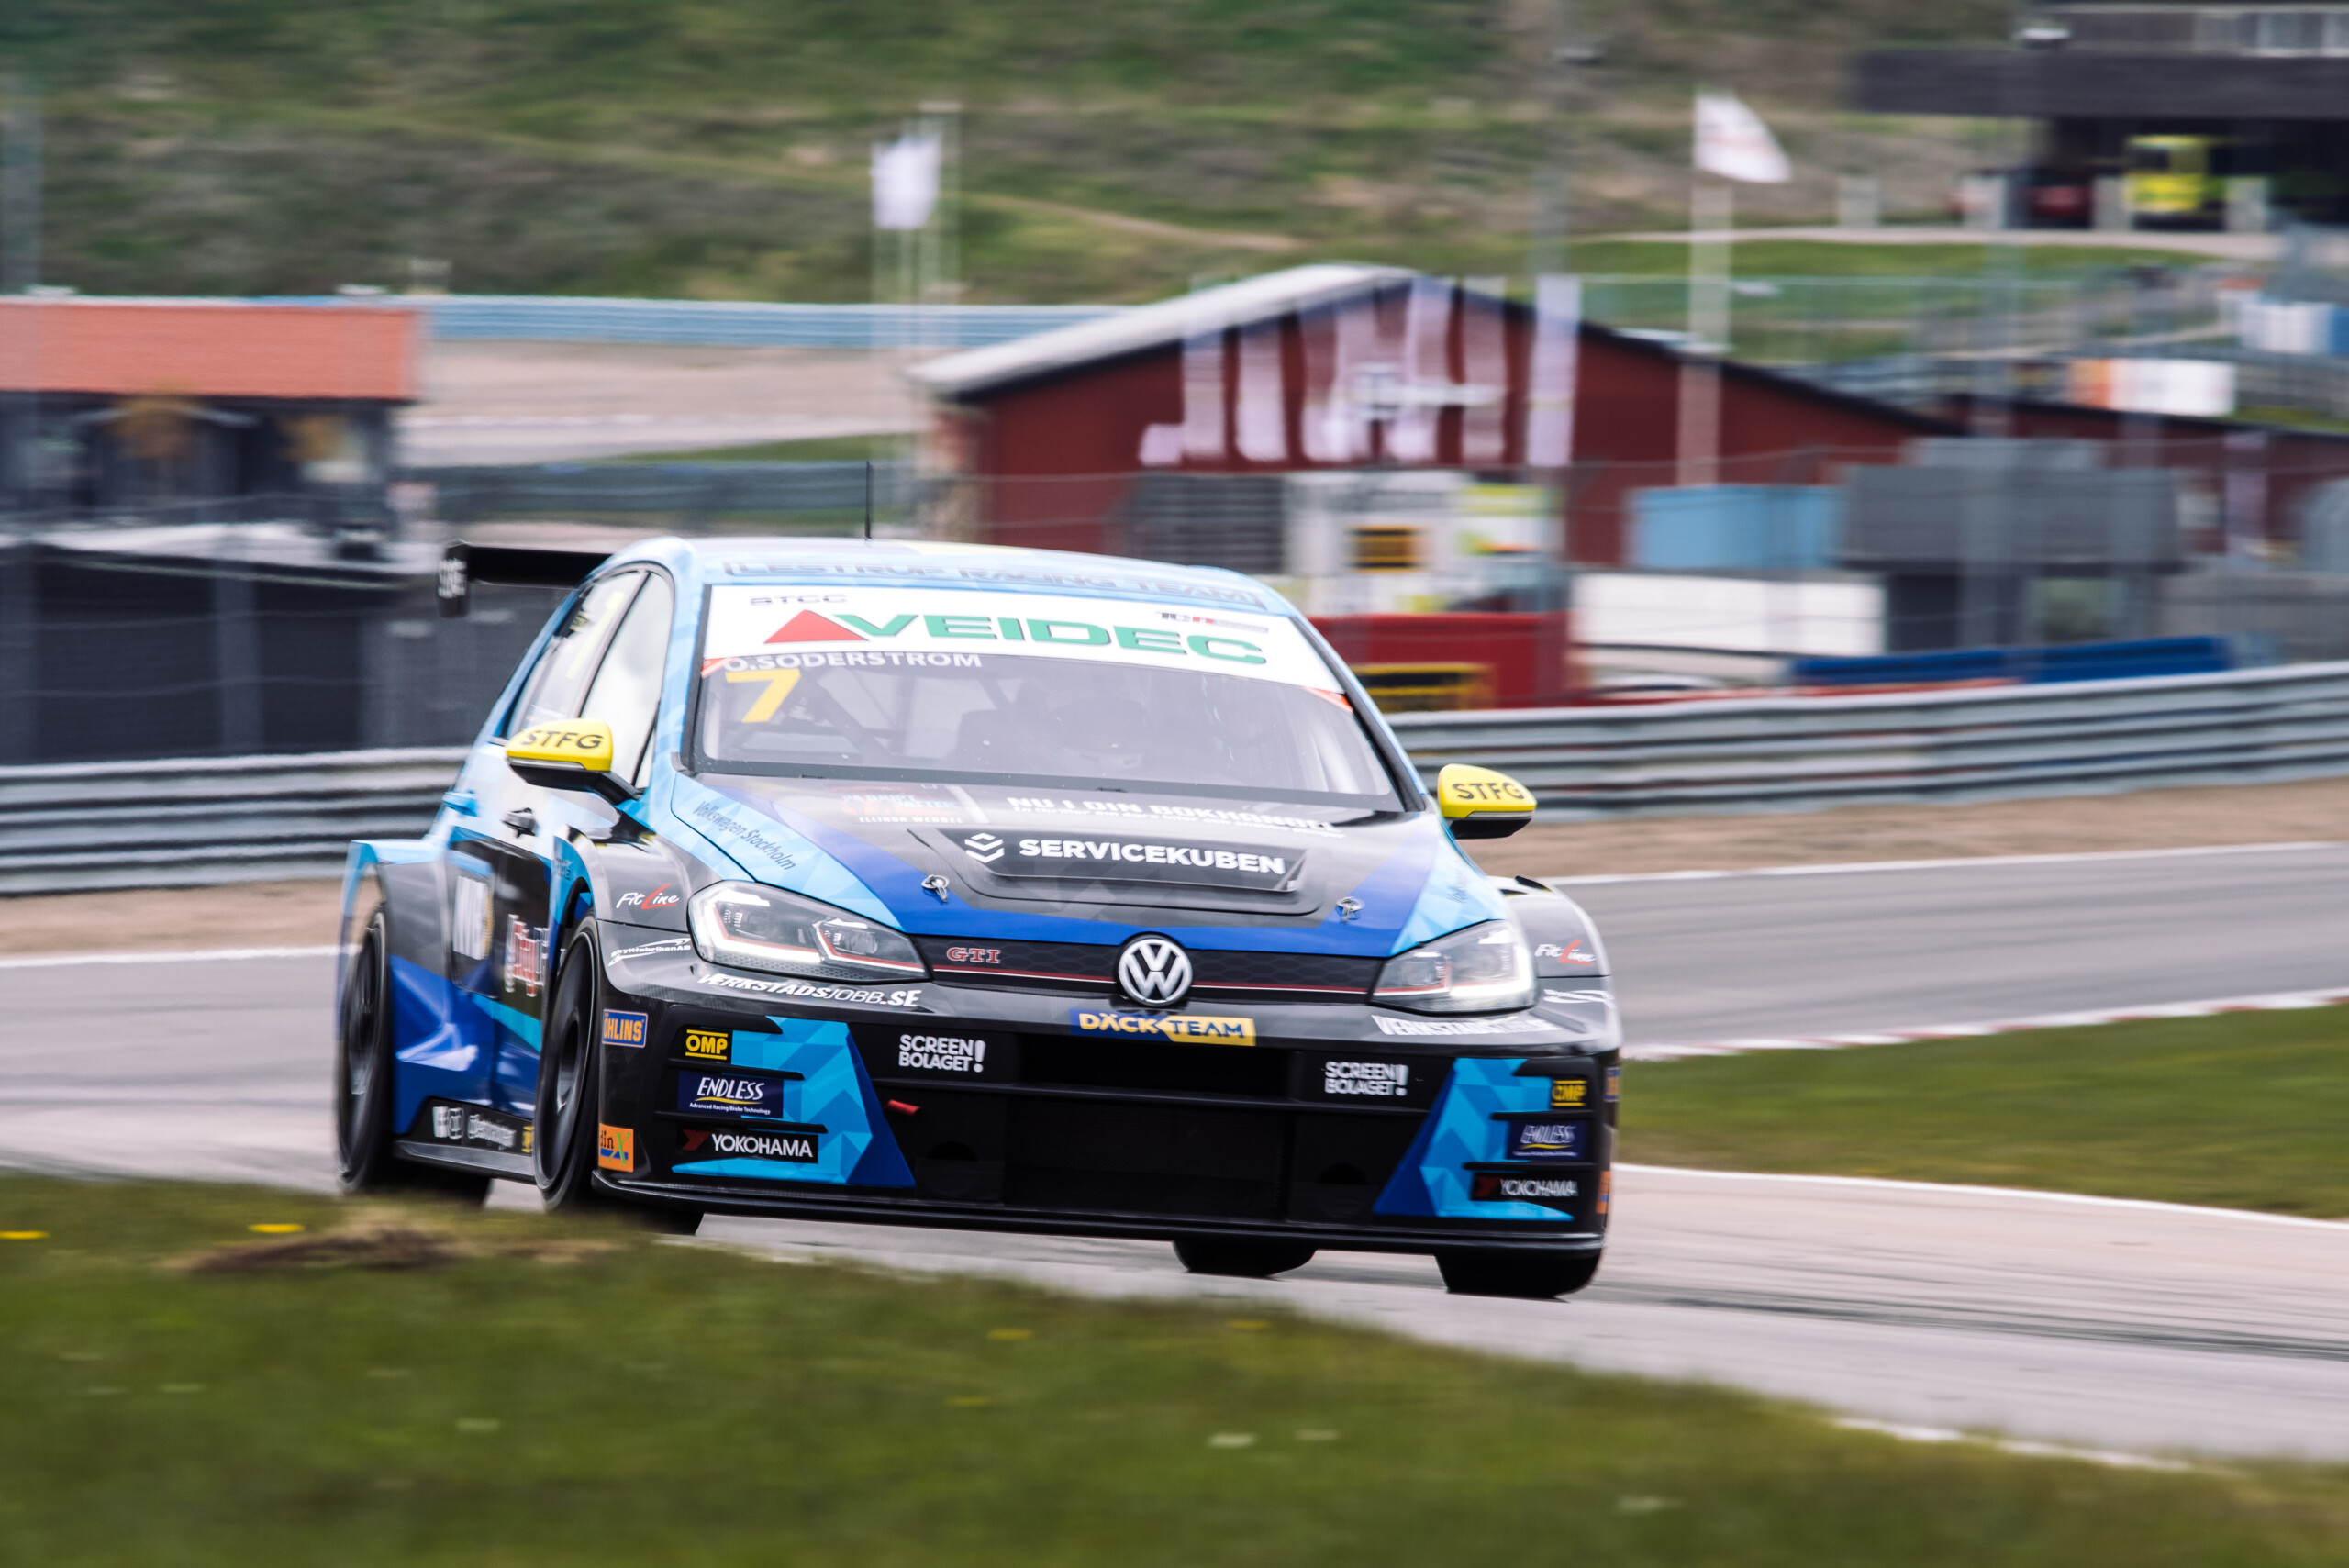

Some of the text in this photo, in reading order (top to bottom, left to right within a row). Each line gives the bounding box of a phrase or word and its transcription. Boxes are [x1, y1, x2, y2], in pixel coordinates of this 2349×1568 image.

[833, 614, 1266, 664] VEIDEC
[725, 668, 801, 723] 7
[521, 729, 604, 750] STFG
[1453, 782, 1525, 800] STFG
[1007, 797, 1055, 808] NU
[1062, 799, 1076, 809] I
[1083, 801, 1143, 813] DIN
[693, 800, 796, 870] Volkswagen Stockholm
[1019, 839, 1285, 874] SERVICEKUBEN
[946, 946, 1002, 964] GTI
[603, 1013, 643, 1042] ÖHLINS
[1079, 1012, 1247, 1039] DÄCK TEAM
[685, 1032, 728, 1056] OMP
[899, 1034, 974, 1056] SCREEN
[697, 1077, 765, 1100] ENDLESS
[689, 1102, 713, 1110] Advanced
[713, 1104, 729, 1112] Racing
[743, 1106, 771, 1116] Technology
[712, 1133, 813, 1157] YOKOHAMA
[1500, 1179, 1579, 1197] YOKOHAMA
